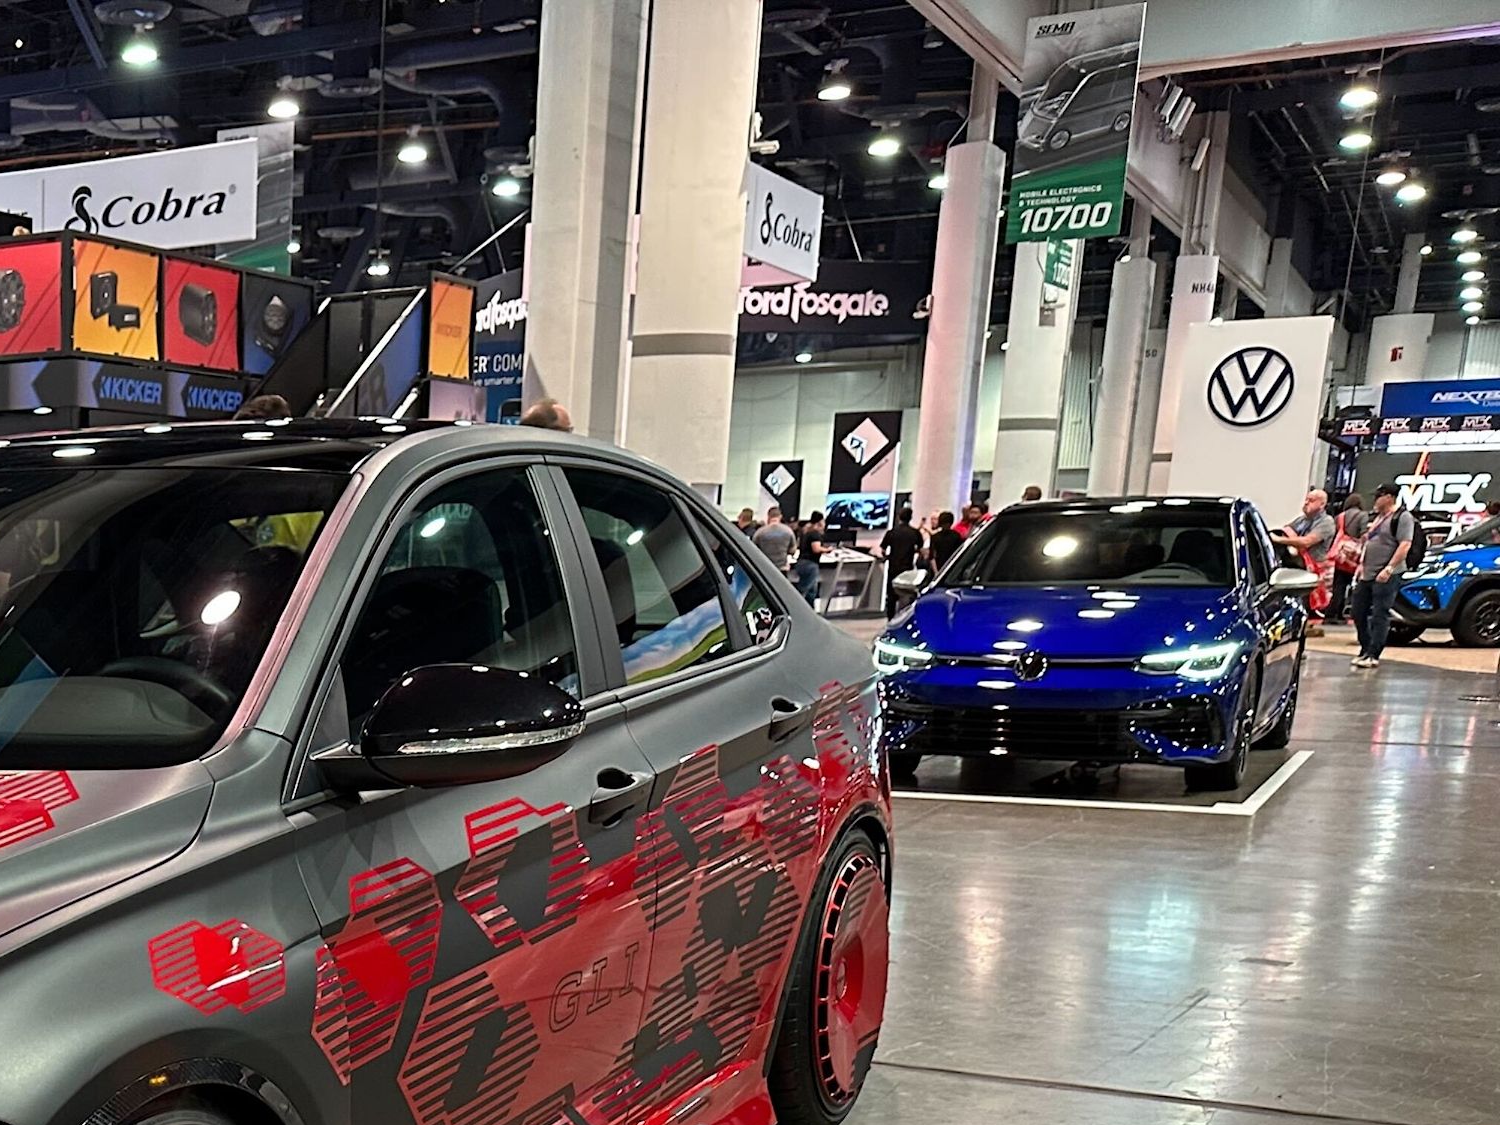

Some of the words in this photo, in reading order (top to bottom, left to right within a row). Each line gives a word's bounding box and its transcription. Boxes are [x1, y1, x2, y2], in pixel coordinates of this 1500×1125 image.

[102, 187, 226, 229] Cobra
[1019, 189, 1048, 199] MOBILE
[1049, 184, 1102, 197] ELECTRONICS
[1026, 196, 1077, 206] TECHNOLOGY
[773, 213, 814, 252] Cobra
[1020, 201, 1113, 234] 10700
[111, 378, 163, 405] KICKER
[1395, 473, 1492, 513] MTX
[549, 941, 640, 1034] GLI
